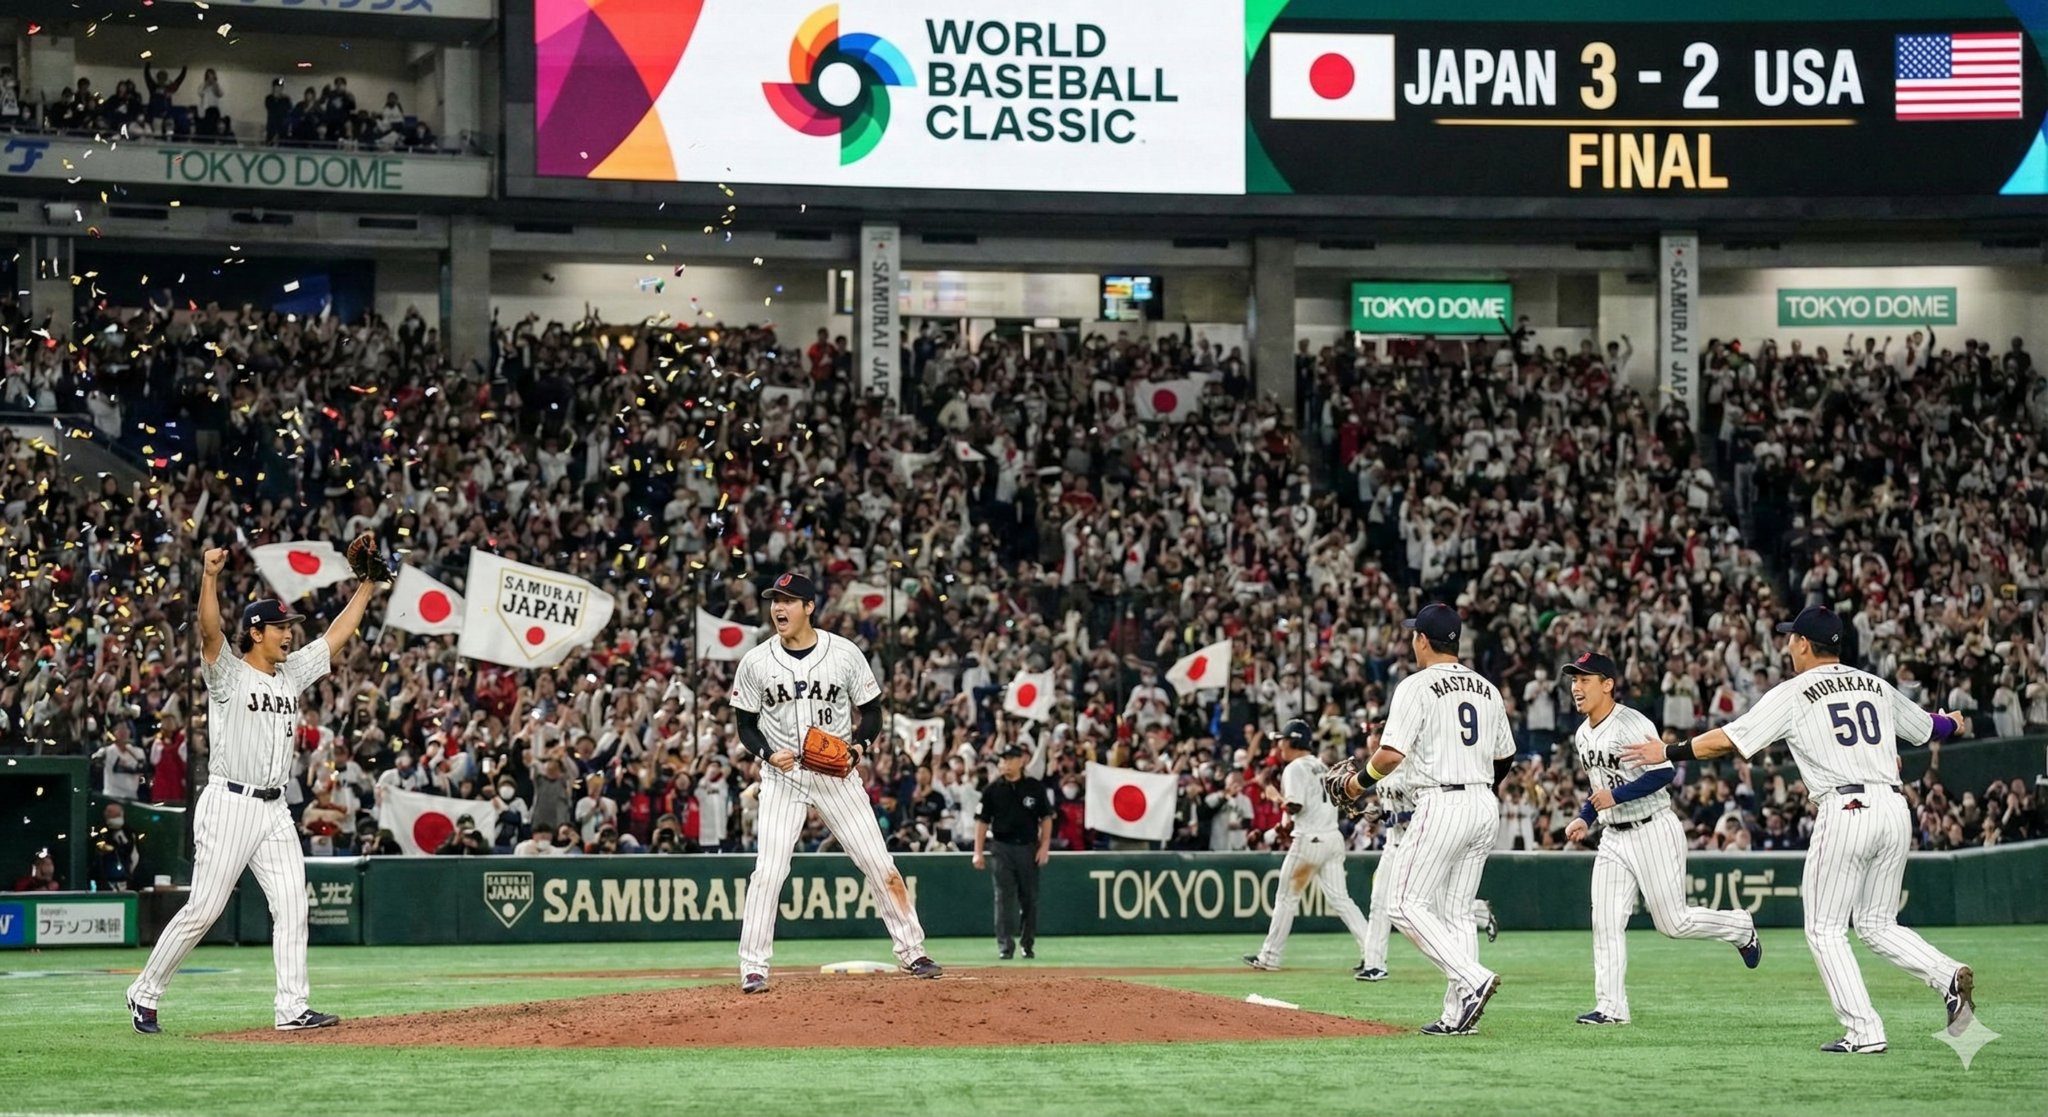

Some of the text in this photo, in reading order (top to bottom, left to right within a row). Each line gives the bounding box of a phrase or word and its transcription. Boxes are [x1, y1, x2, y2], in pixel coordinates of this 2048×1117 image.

[925, 18, 1106, 58] WORLD
[928, 62, 1179, 103] BASEBALL
[1403, 48, 1556, 106] JAPAN
[1579, 41, 1618, 110] 3
[1682, 42, 1720, 110] 2
[1754, 48, 1865, 106] USA
[925, 104, 1137, 144] CLASSIC
[158, 149, 403, 190] TOKYO DOME
[1568, 133, 1728, 190] FINAL
[872, 260, 890, 348] SAMURAI
[1358, 296, 1504, 319] TOKYO DOME
[1670, 267, 1688, 353] SAMURAI
[1786, 297, 1949, 318] TOKYO DOME
[872, 356, 889, 399] JAP
[1671, 361, 1688, 396] JAP
[504, 575, 583, 604] SAMURAI
[502, 593, 579, 627] JAPAN
[764, 680, 841, 708] JAPAN
[1803, 676, 1883, 704] MURAKAKA
[817, 707, 833, 726] 18
[1457, 701, 1479, 747] 9
[1827, 700, 1882, 747] 50
[1581, 749, 1621, 771] APAN
[487, 885, 531, 900] JAPAN
[543, 877, 747, 923] SAMURAI
[1089, 869, 1224, 919] TOKYO
